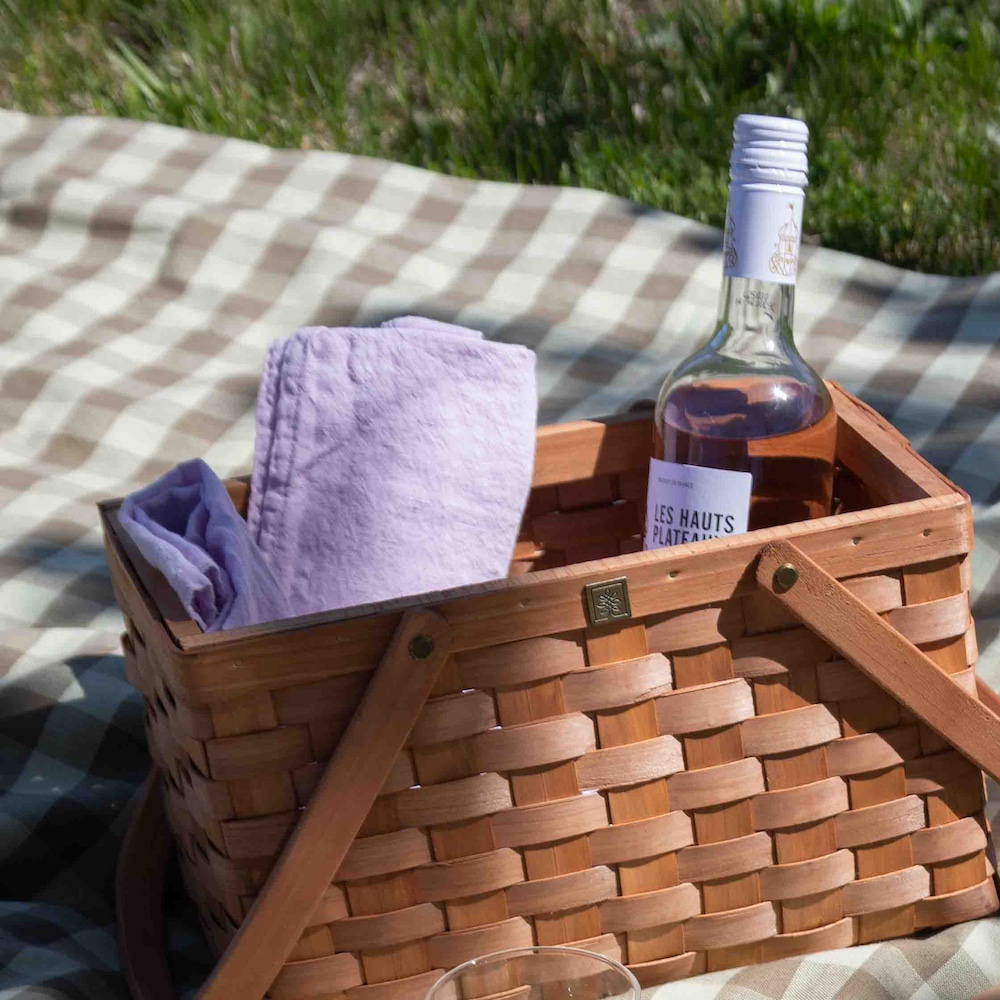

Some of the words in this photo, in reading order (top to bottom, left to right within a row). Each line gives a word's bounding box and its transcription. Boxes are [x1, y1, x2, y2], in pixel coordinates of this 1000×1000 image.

[654, 503, 674, 525] LES
[680, 508, 735, 534] HAUTS
[653, 526, 720, 546] PLATEA
